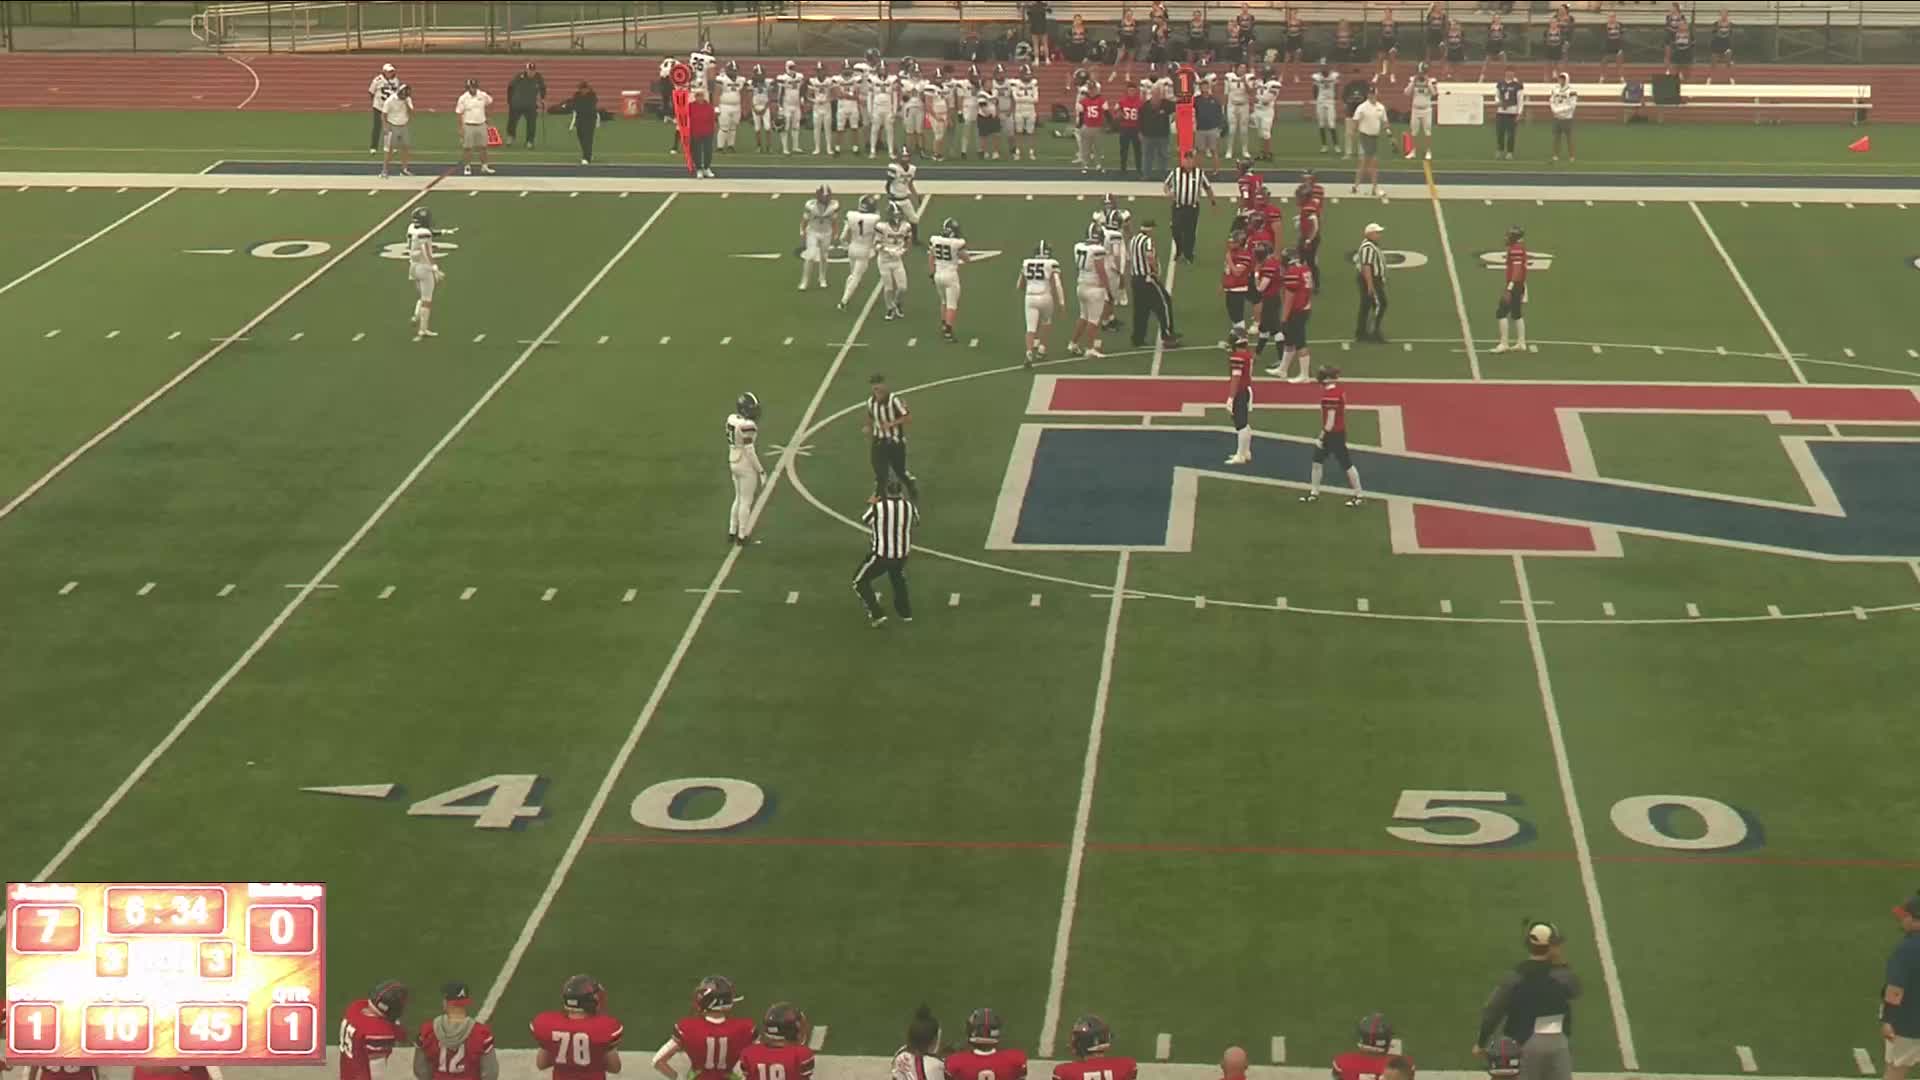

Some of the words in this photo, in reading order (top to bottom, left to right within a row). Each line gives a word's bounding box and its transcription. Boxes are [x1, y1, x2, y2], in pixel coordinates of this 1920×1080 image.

[1179, 73, 1189, 92] 1
[1087, 106, 1100, 119] 15
[857, 219, 865, 236] 1
[935, 243, 953, 261] 33
[1027, 262, 1045, 281] 55
[550, 1029, 591, 1066] 78
[705, 1035, 729, 1070] 11
